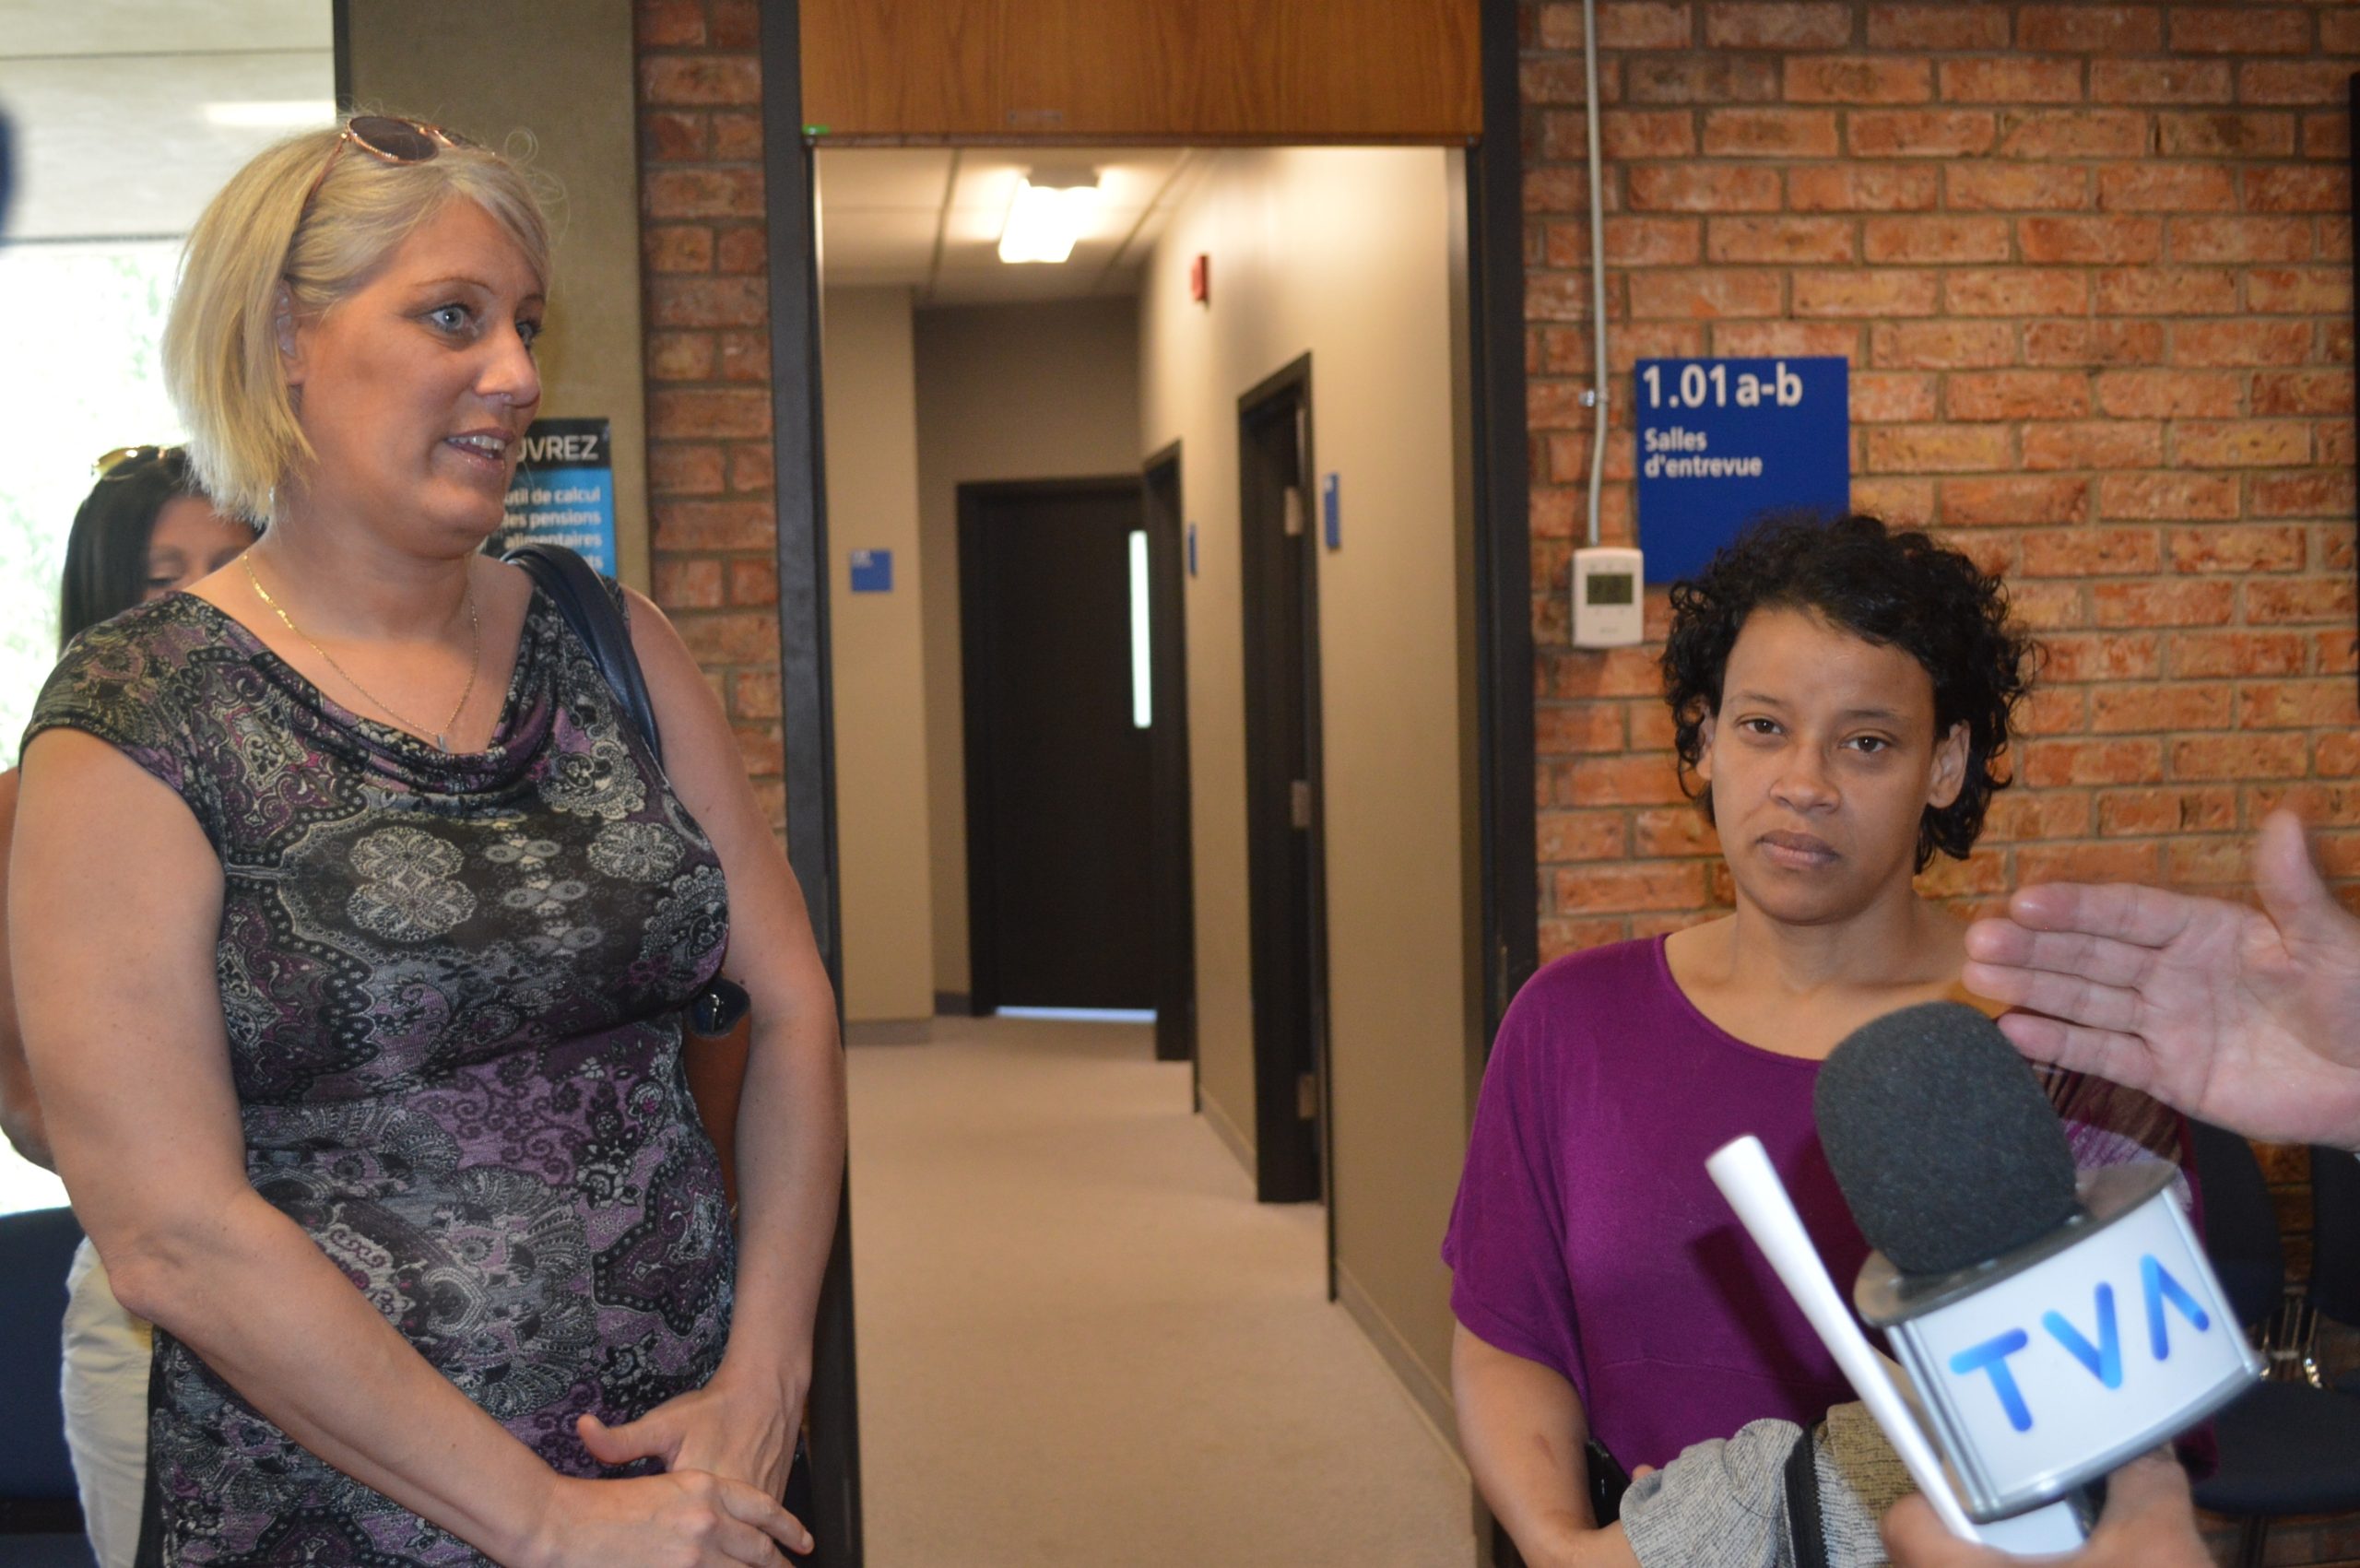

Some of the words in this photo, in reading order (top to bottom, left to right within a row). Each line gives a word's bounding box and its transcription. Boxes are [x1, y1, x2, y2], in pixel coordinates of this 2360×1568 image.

[1643, 363, 1728, 408] 1.01
[1735, 360, 1804, 407] a-b
[1644, 426, 1707, 453] Salles
[1644, 454, 1764, 478] d'entrevue
[531, 488, 551, 504] de
[555, 487, 600, 503] calcul
[530, 509, 601, 529] pensions
[1949, 1253, 2211, 1433] TVA
